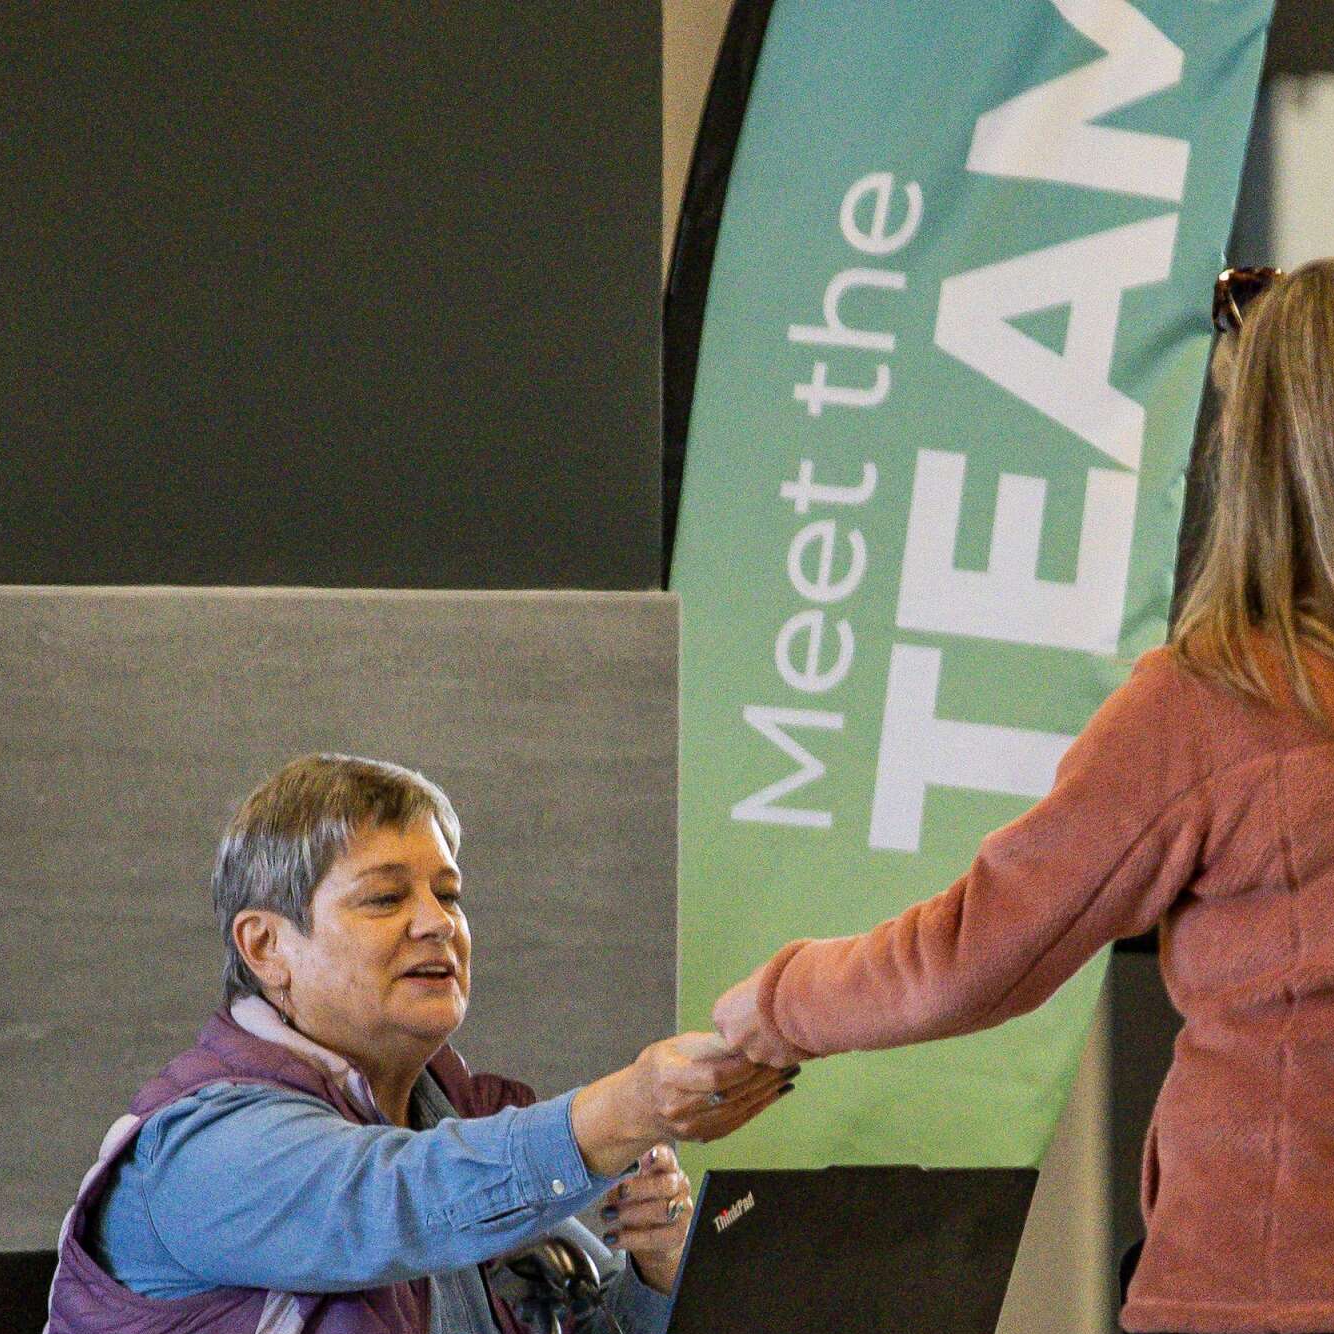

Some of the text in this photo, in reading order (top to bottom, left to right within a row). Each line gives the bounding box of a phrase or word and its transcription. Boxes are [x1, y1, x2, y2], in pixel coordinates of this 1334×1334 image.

[731, 171, 924, 829] Meet the
[868, 0, 1192, 853] TEAM
[713, 1190, 756, 1232] ThinkPad
